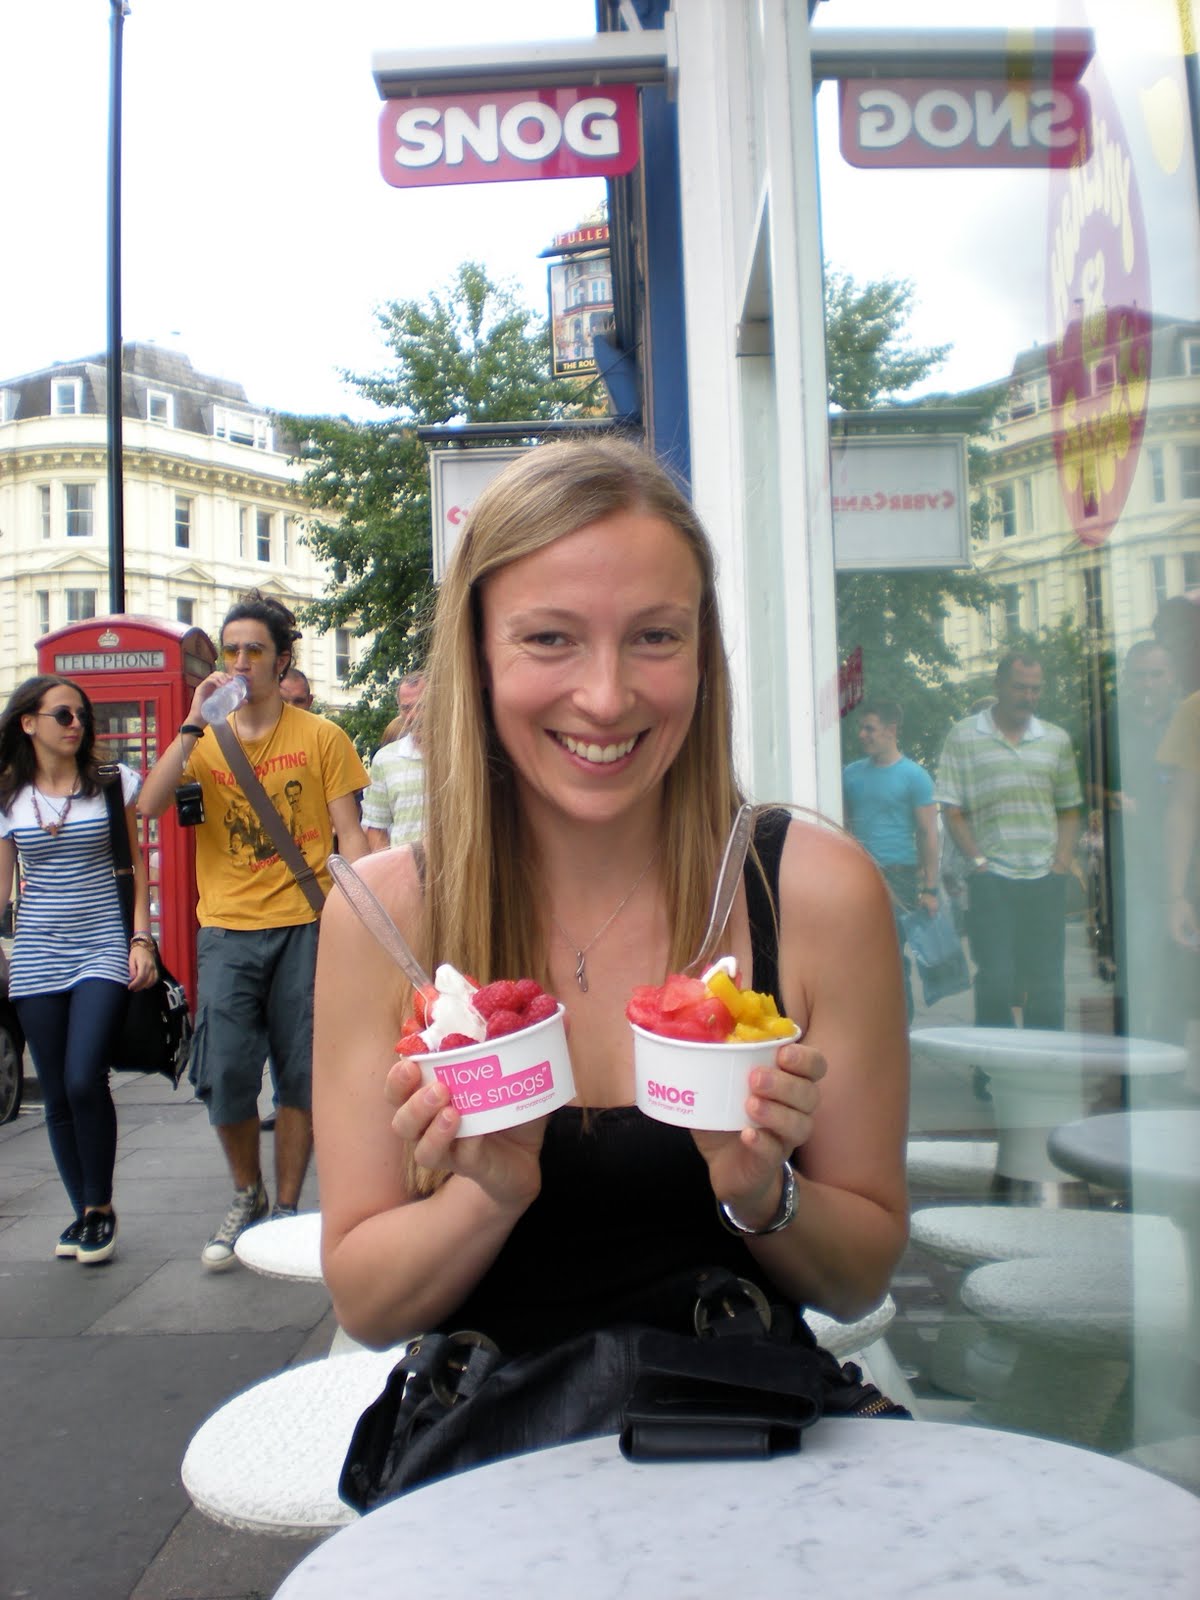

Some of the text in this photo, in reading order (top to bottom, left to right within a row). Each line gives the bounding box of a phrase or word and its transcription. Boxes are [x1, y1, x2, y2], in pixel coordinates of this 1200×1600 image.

[394, 98, 620, 167] SNOG
[563, 362, 577, 370] THE
[62, 653, 160, 670] TELEPHONE
[452, 1064, 494, 1086] love
[647, 1080, 695, 1106] SNOG
